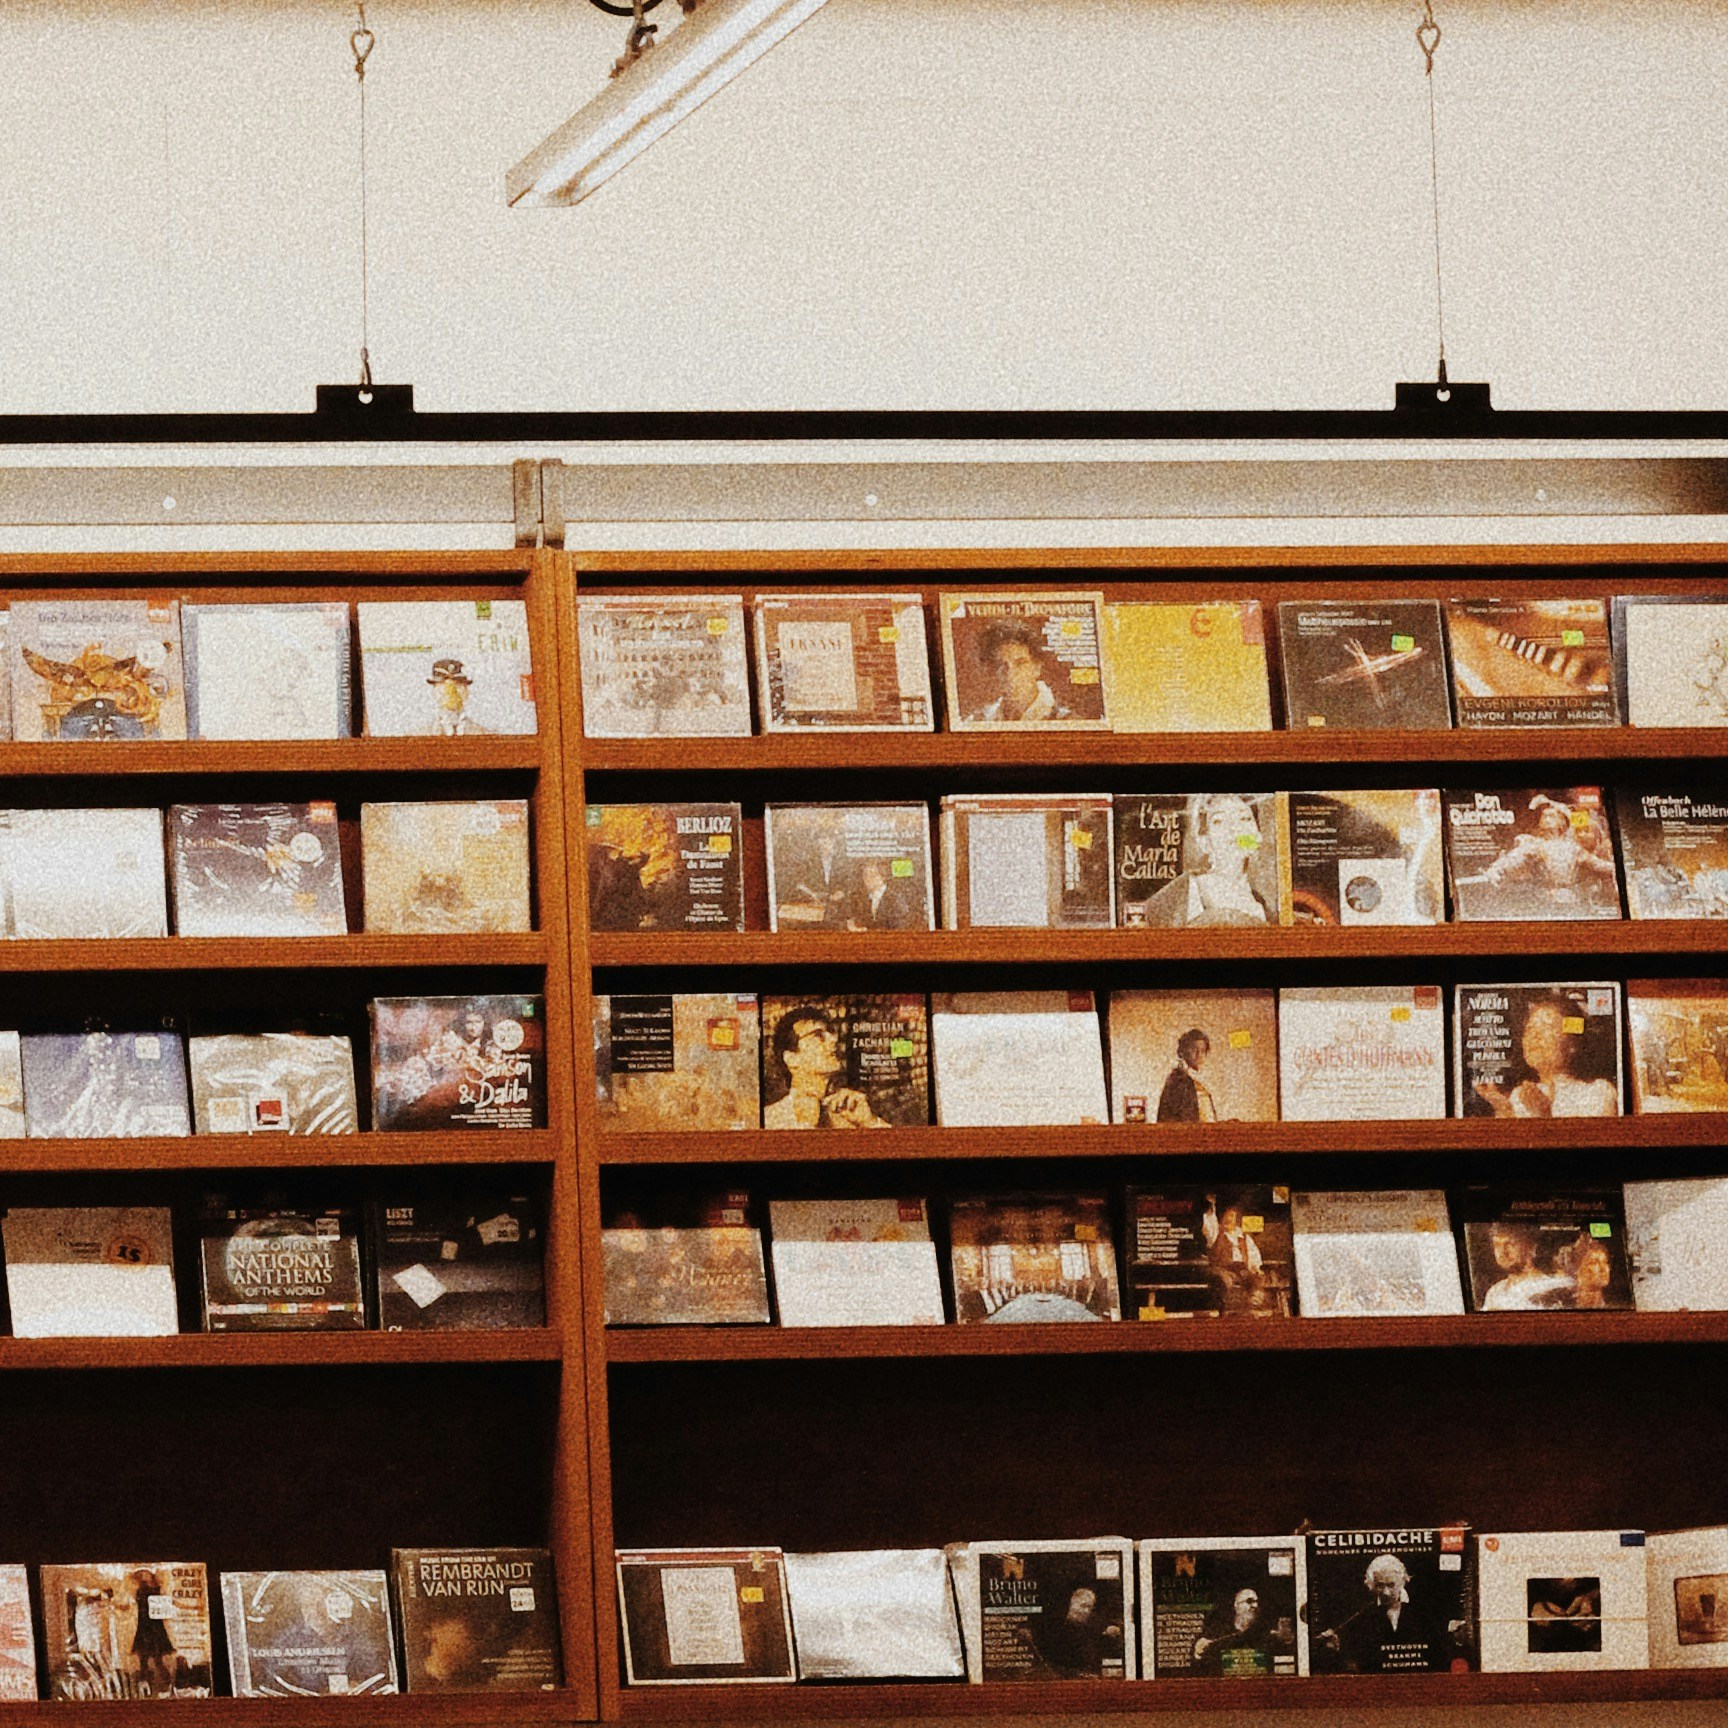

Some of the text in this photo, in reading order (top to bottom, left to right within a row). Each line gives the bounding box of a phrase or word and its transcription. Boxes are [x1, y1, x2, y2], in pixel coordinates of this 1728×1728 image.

[1513, 711, 1558, 721] MOZART
[1474, 792, 1501, 811] Don
[1641, 795, 1692, 807] Offenbach
[1139, 802, 1180, 829] l'Art
[1643, 805, 1658, 819] La
[1659, 804, 1690, 819] Belle
[676, 816, 733, 834] BERLIOZ
[1160, 826, 1181, 845] de
[1123, 844, 1179, 863] Maria
[1120, 861, 1178, 880] Callas
[1467, 997, 1509, 1011] NORMA
[852, 1021, 905, 1033] CHRISTIAN
[464, 1055, 533, 1084] Samson
[458, 1078, 529, 1109] & Dalila
[386, 1207, 414, 1220] LISZT
[118, 1244, 143, 1263] 15
[230, 1253, 335, 1271] NATIONAL
[232, 1268, 333, 1285] ANTHEMS
[245, 1287, 260, 1297] OF
[283, 1286, 326, 1297] WORLD
[1314, 1532, 1434, 1547] CELIBIDACHE
[171, 1568, 204, 1578] CRAZY
[420, 1561, 534, 1581] REMBRANDT
[180, 1579, 203, 1589] GIRL
[422, 1580, 505, 1597] VAN RIJN
[989, 1577, 1038, 1592] Bruno
[172, 1589, 204, 1600] CRAZY
[987, 1590, 1040, 1605] Walter
